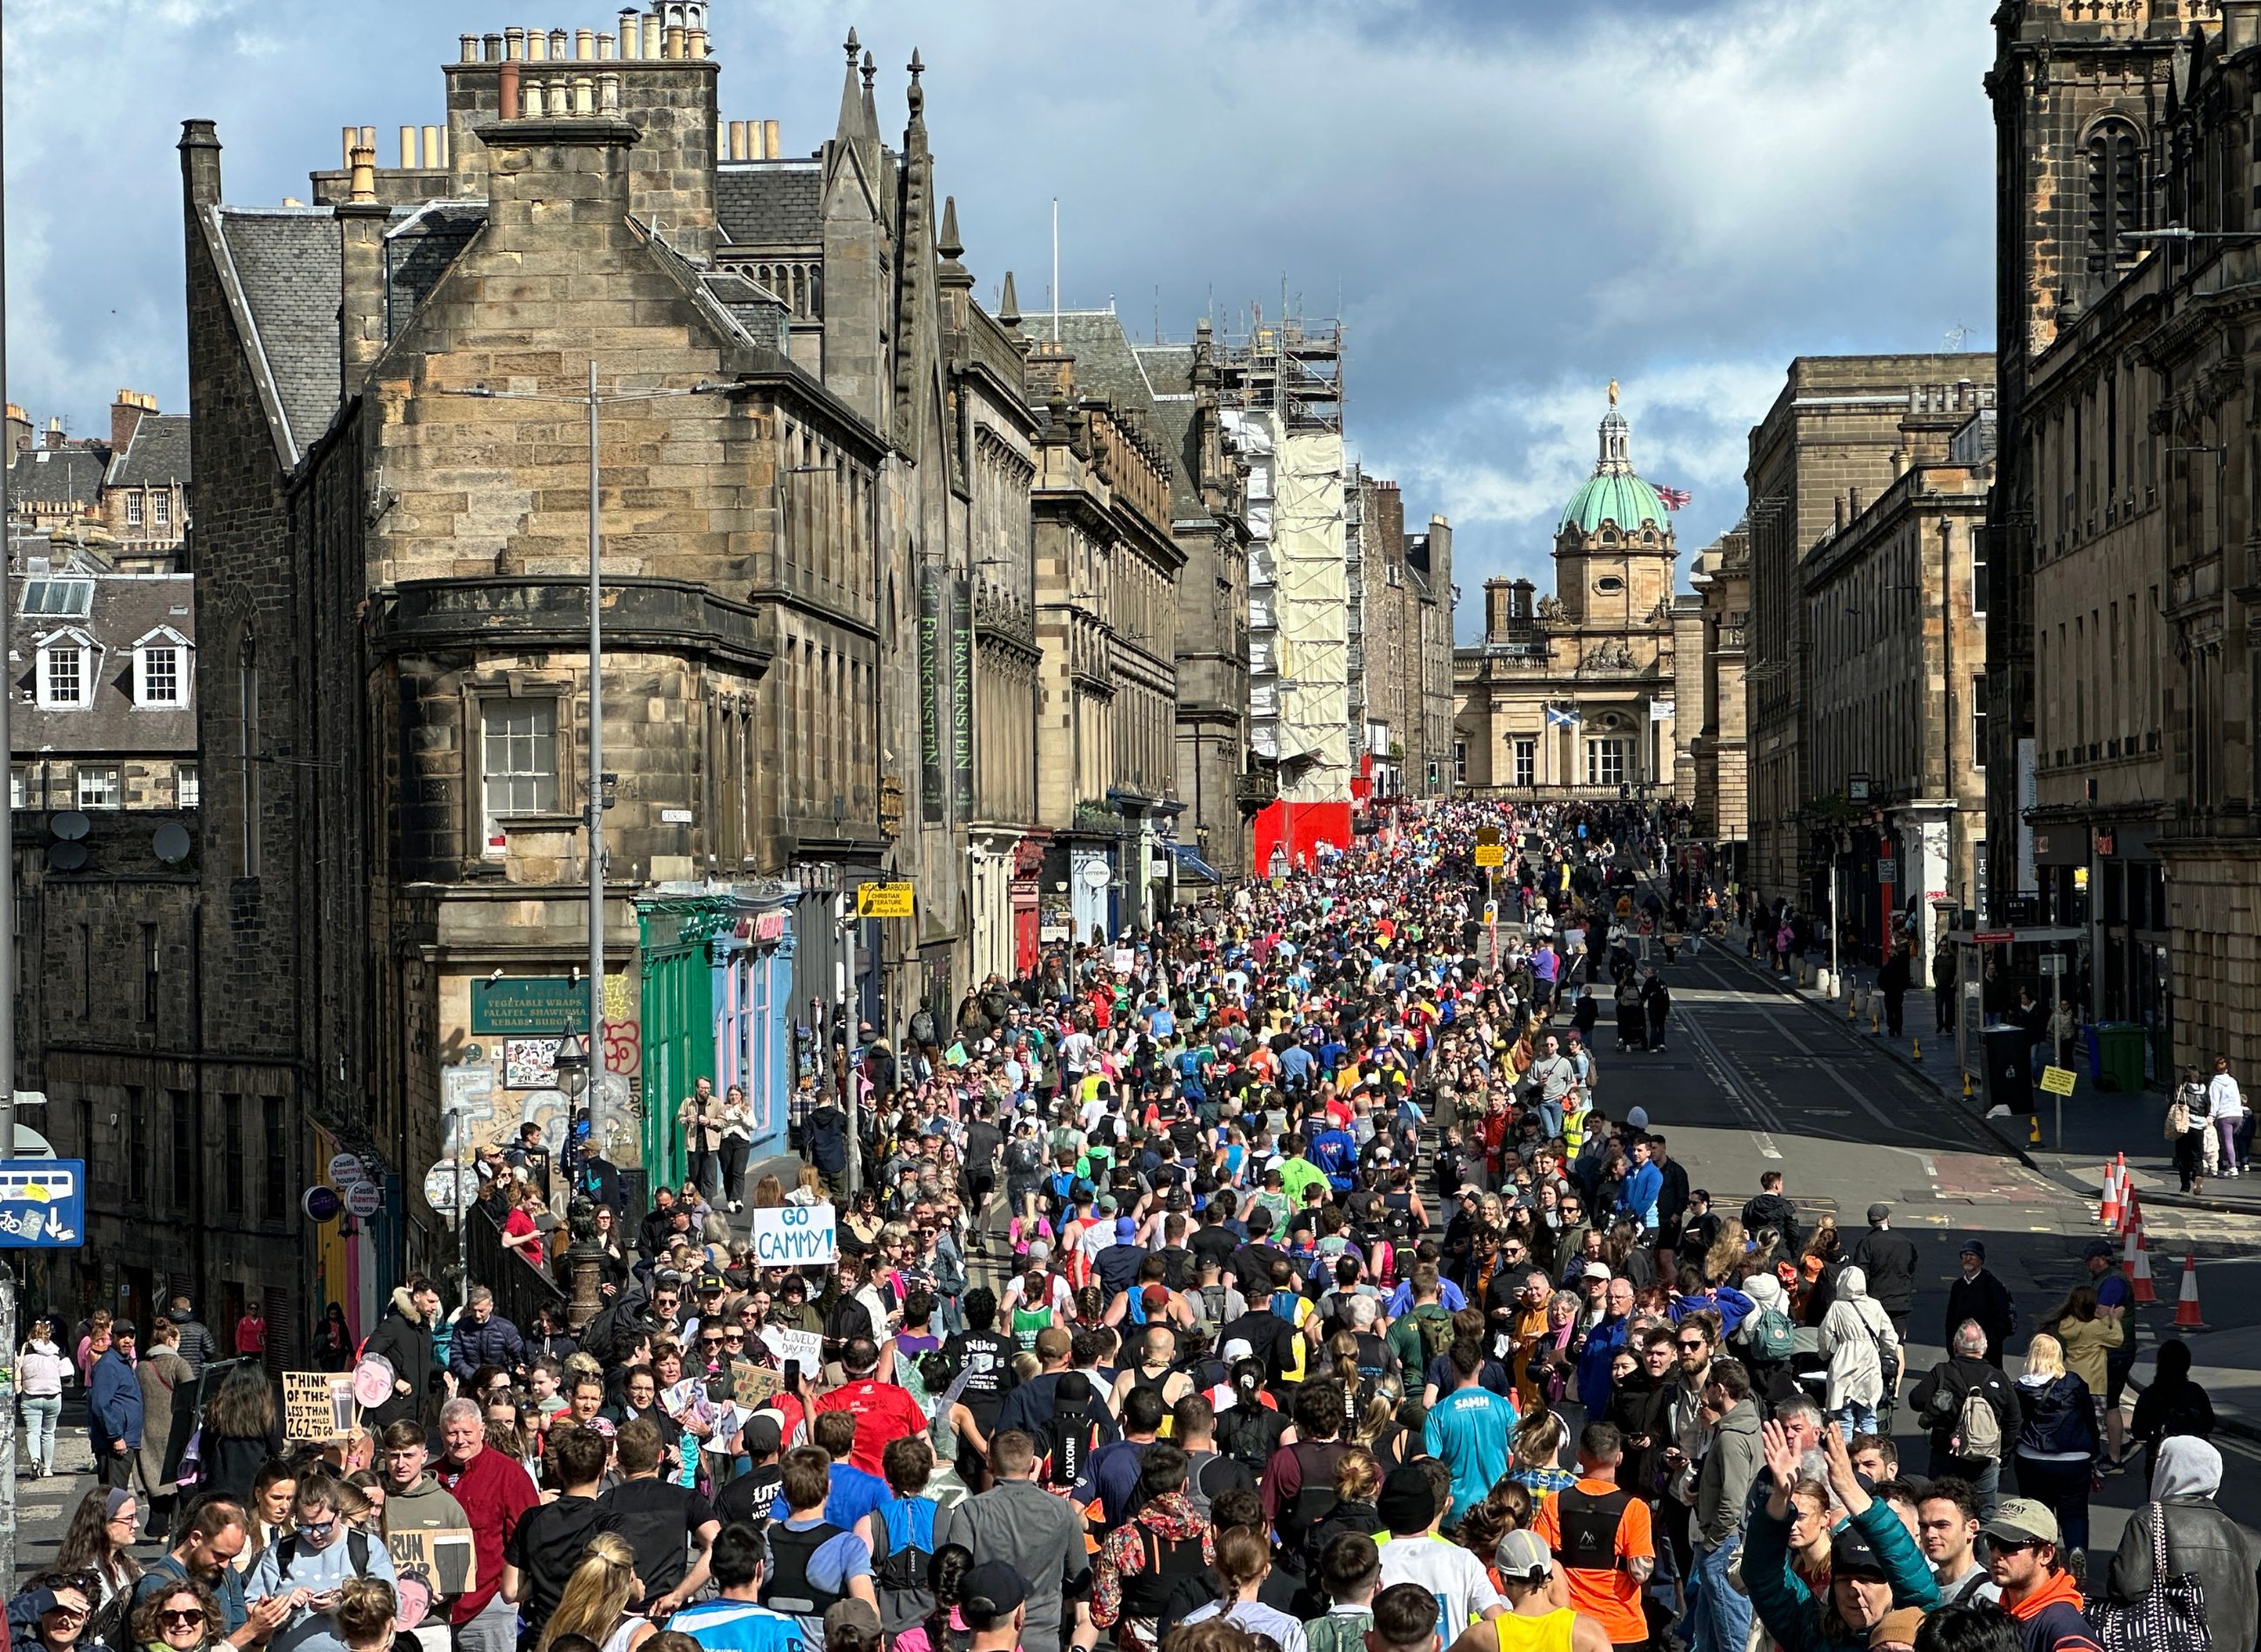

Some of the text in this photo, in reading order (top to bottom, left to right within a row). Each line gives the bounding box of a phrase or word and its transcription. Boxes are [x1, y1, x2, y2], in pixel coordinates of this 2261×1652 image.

[921, 616, 938, 766] FRANKENSTEIN
[954, 629, 971, 769] FRANKENSTEIN
[354, 1204, 374, 1213] house
[782, 1207, 809, 1226] GO
[758, 1229, 834, 1260] CAMMY!
[784, 1331, 819, 1345] LOVELY
[783, 1342, 798, 1354] DAY
[965, 1339, 998, 1352] Nike
[285, 1374, 327, 1388] THINK
[287, 1389, 299, 1402] OF
[303, 1390, 324, 1402] THE
[1454, 1396, 1490, 1409] SAMH
[287, 1406, 329, 1417] LESS THAN
[312, 1425, 333, 1437] TO GO
[1065, 1437, 1076, 1478] INOXTO
[390, 1533, 424, 1562] RUN
